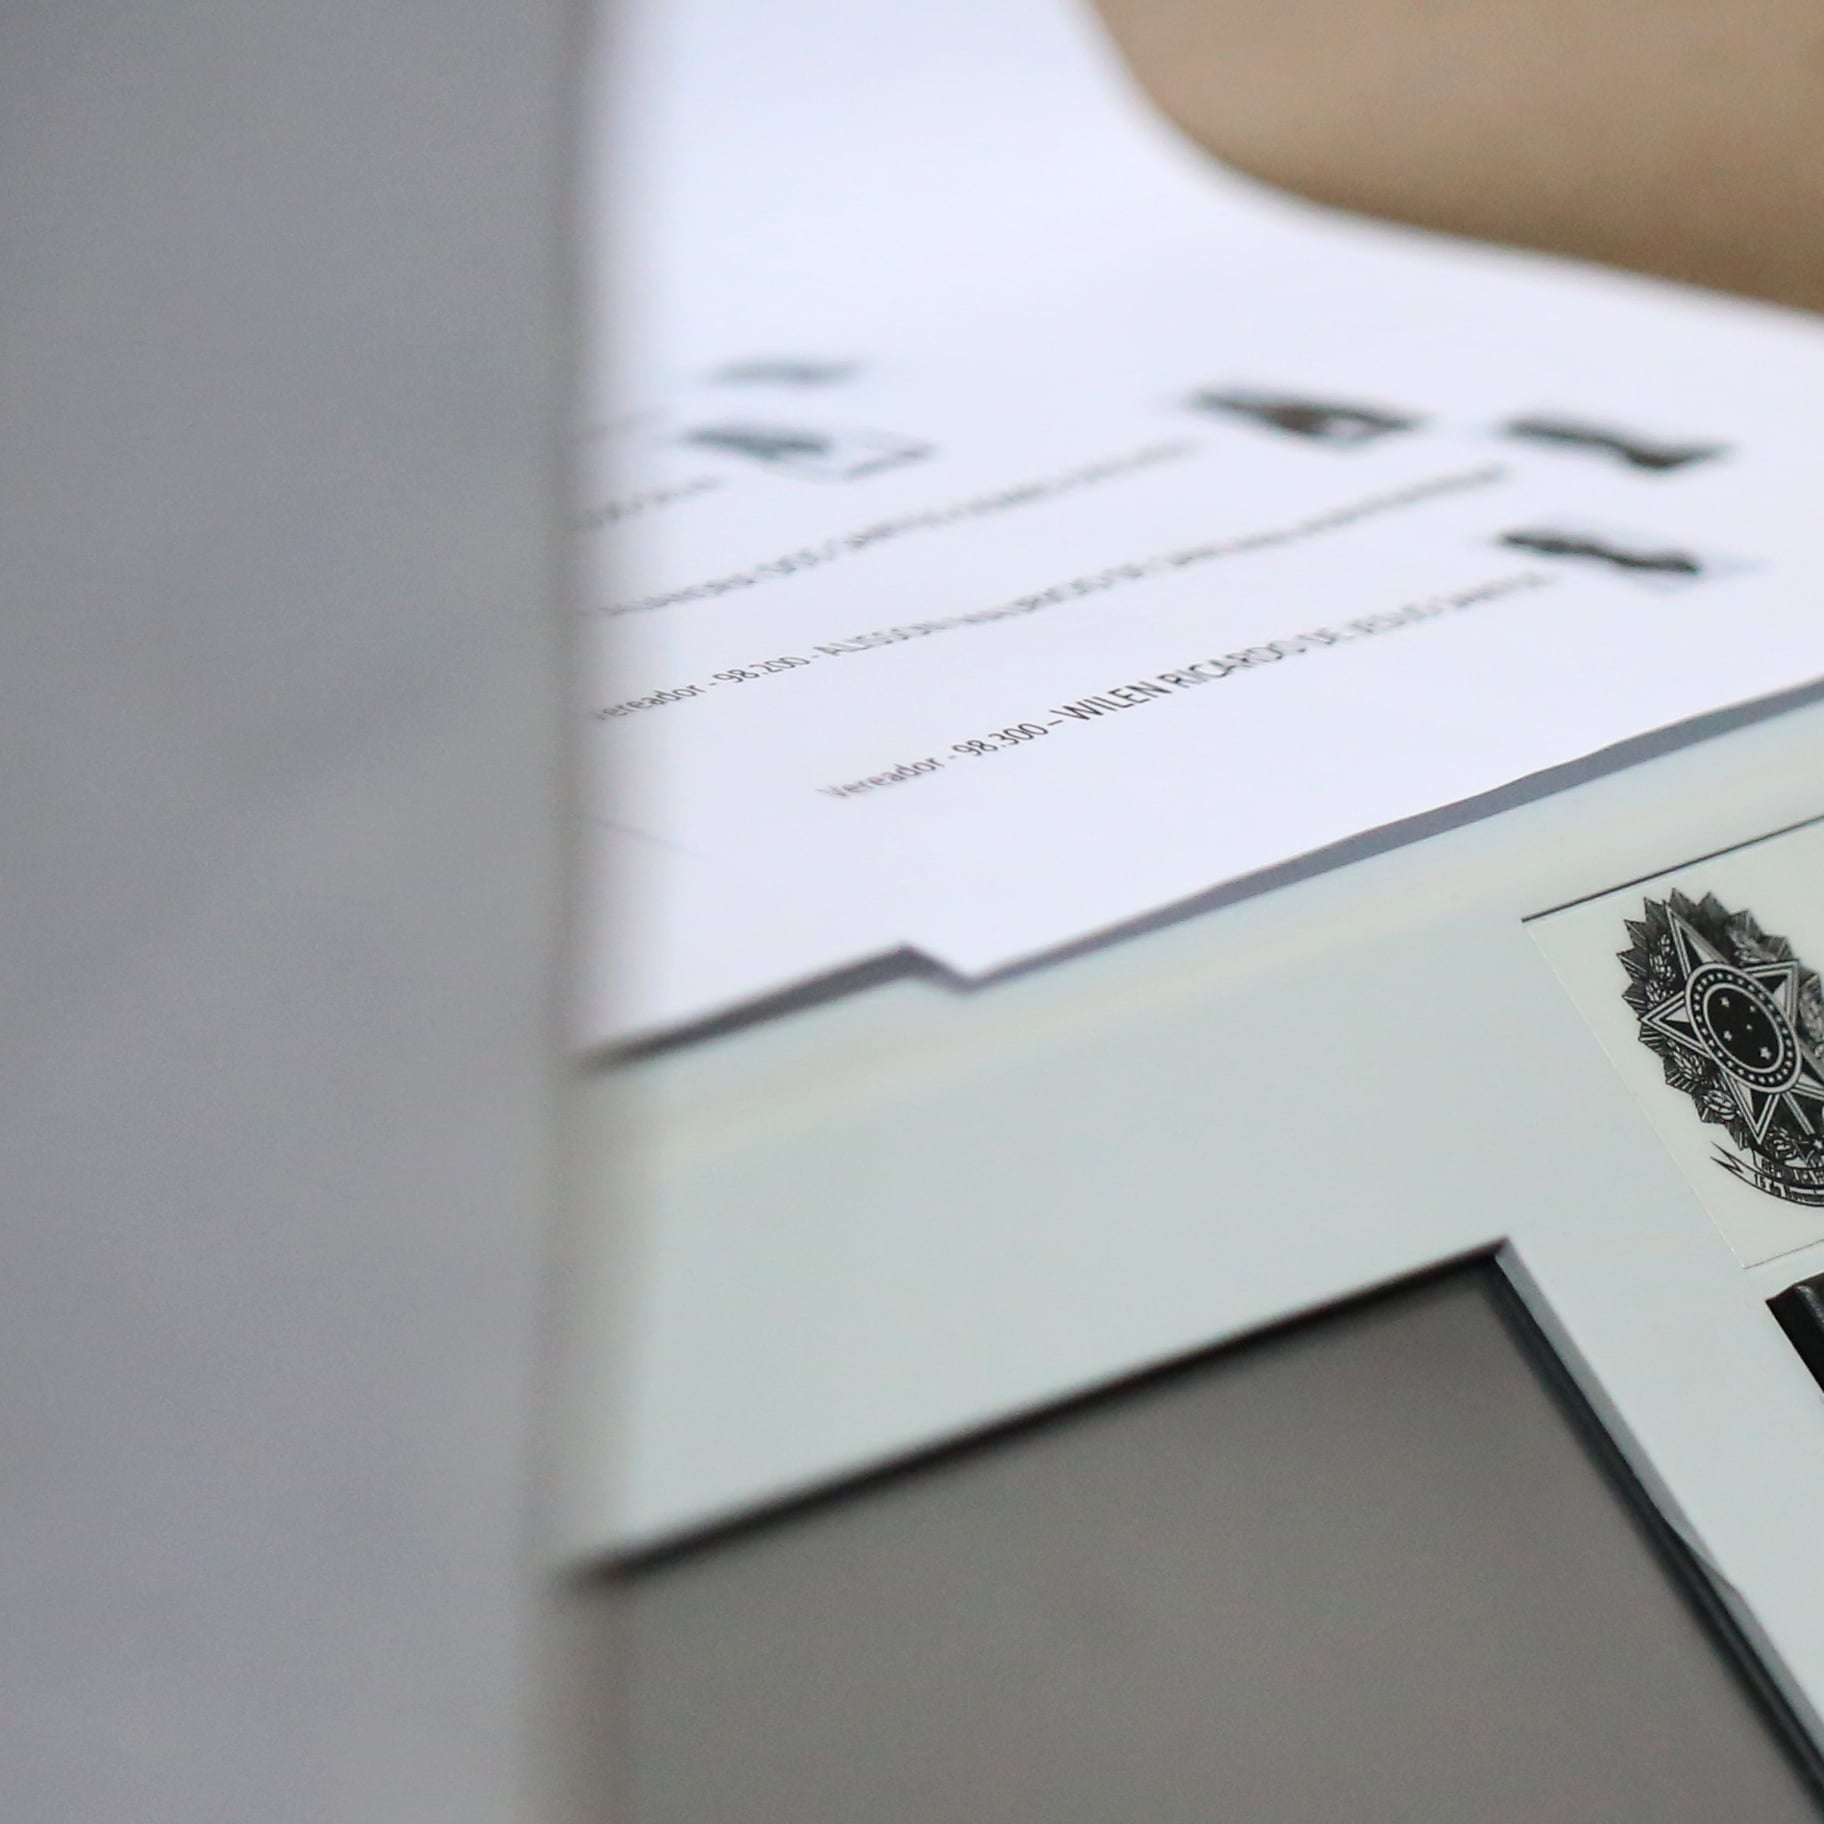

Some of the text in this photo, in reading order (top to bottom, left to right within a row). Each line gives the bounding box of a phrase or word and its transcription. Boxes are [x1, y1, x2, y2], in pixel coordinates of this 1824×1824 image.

[713, 655, 811, 684] 98.200
[817, 757, 945, 799] Vereador
[952, 723, 1050, 757] 98.300
[1049, 681, 1173, 721] WILEN
[1156, 639, 1306, 690] RICARDO
